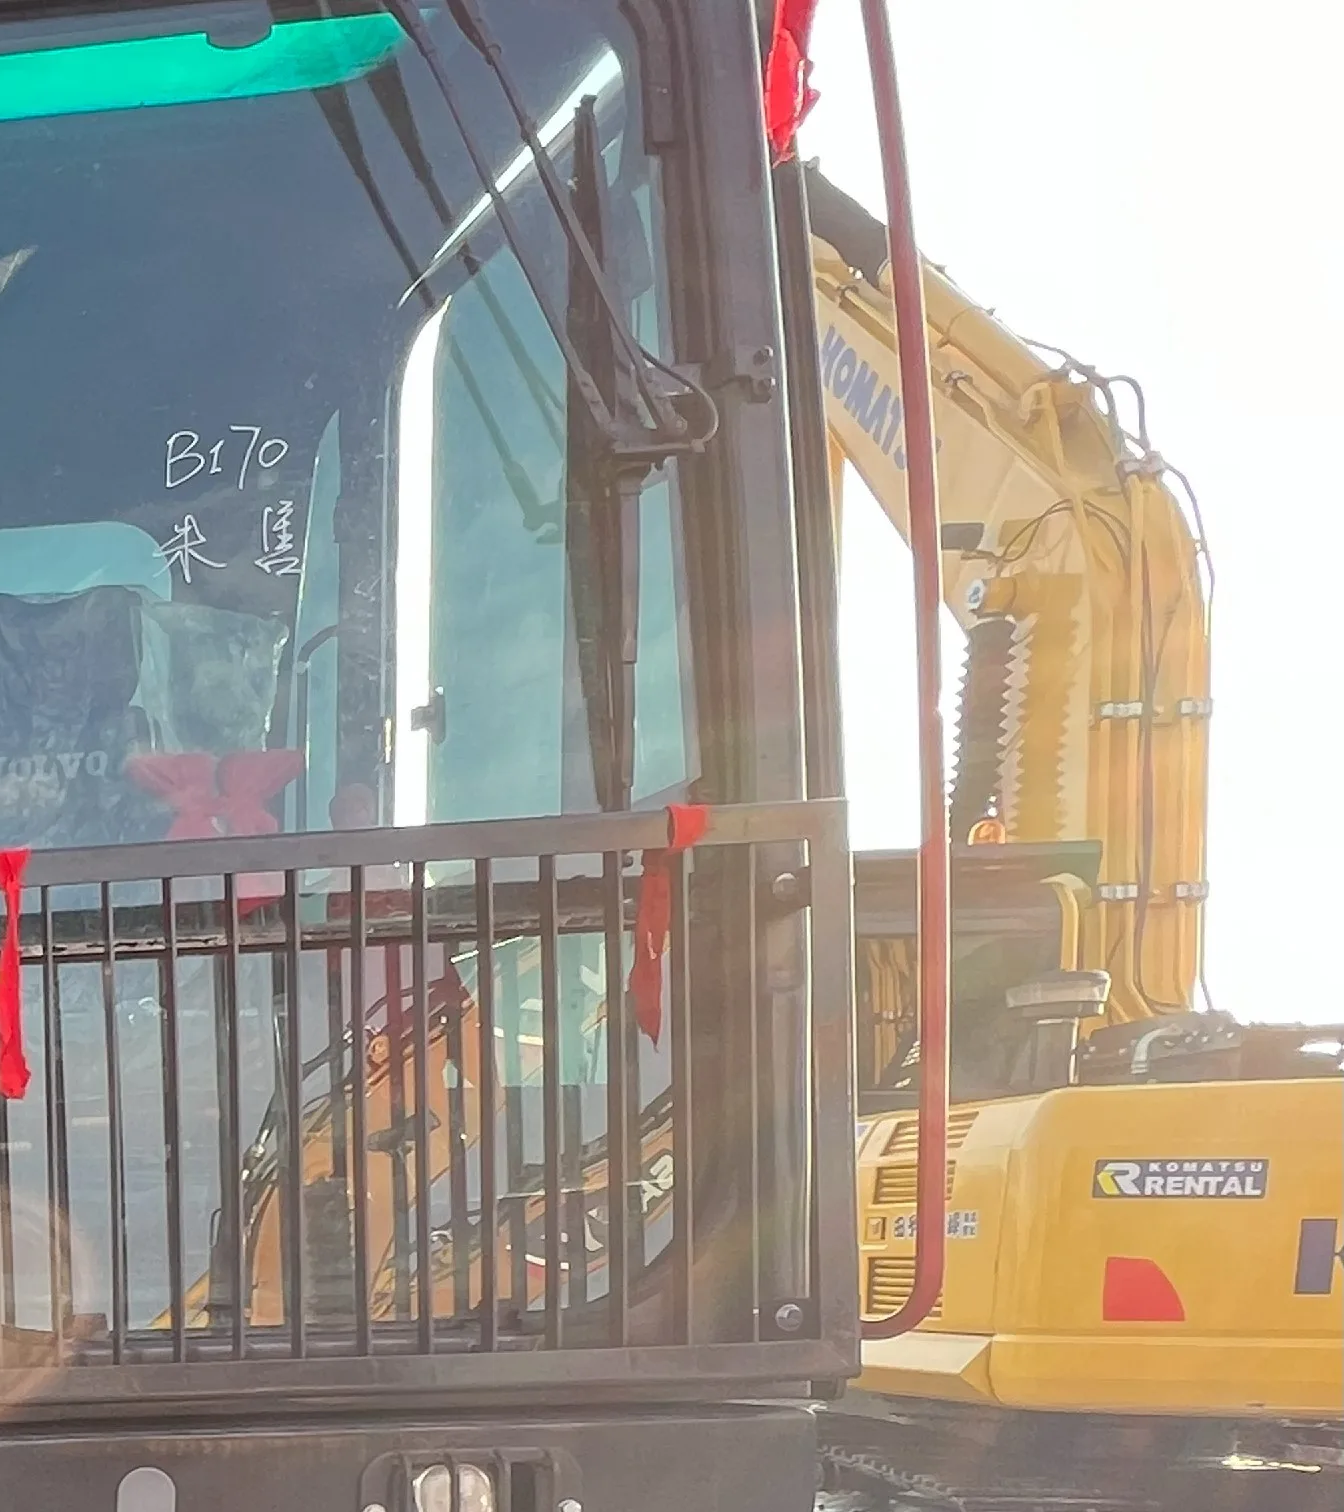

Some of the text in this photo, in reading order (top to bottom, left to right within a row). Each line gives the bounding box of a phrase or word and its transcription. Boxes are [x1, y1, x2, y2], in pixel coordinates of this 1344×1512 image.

[166, 425, 289, 489] B170
[1148, 1162, 1263, 1172] KOMATSU
[1143, 1176, 1262, 1196] RENTAL
